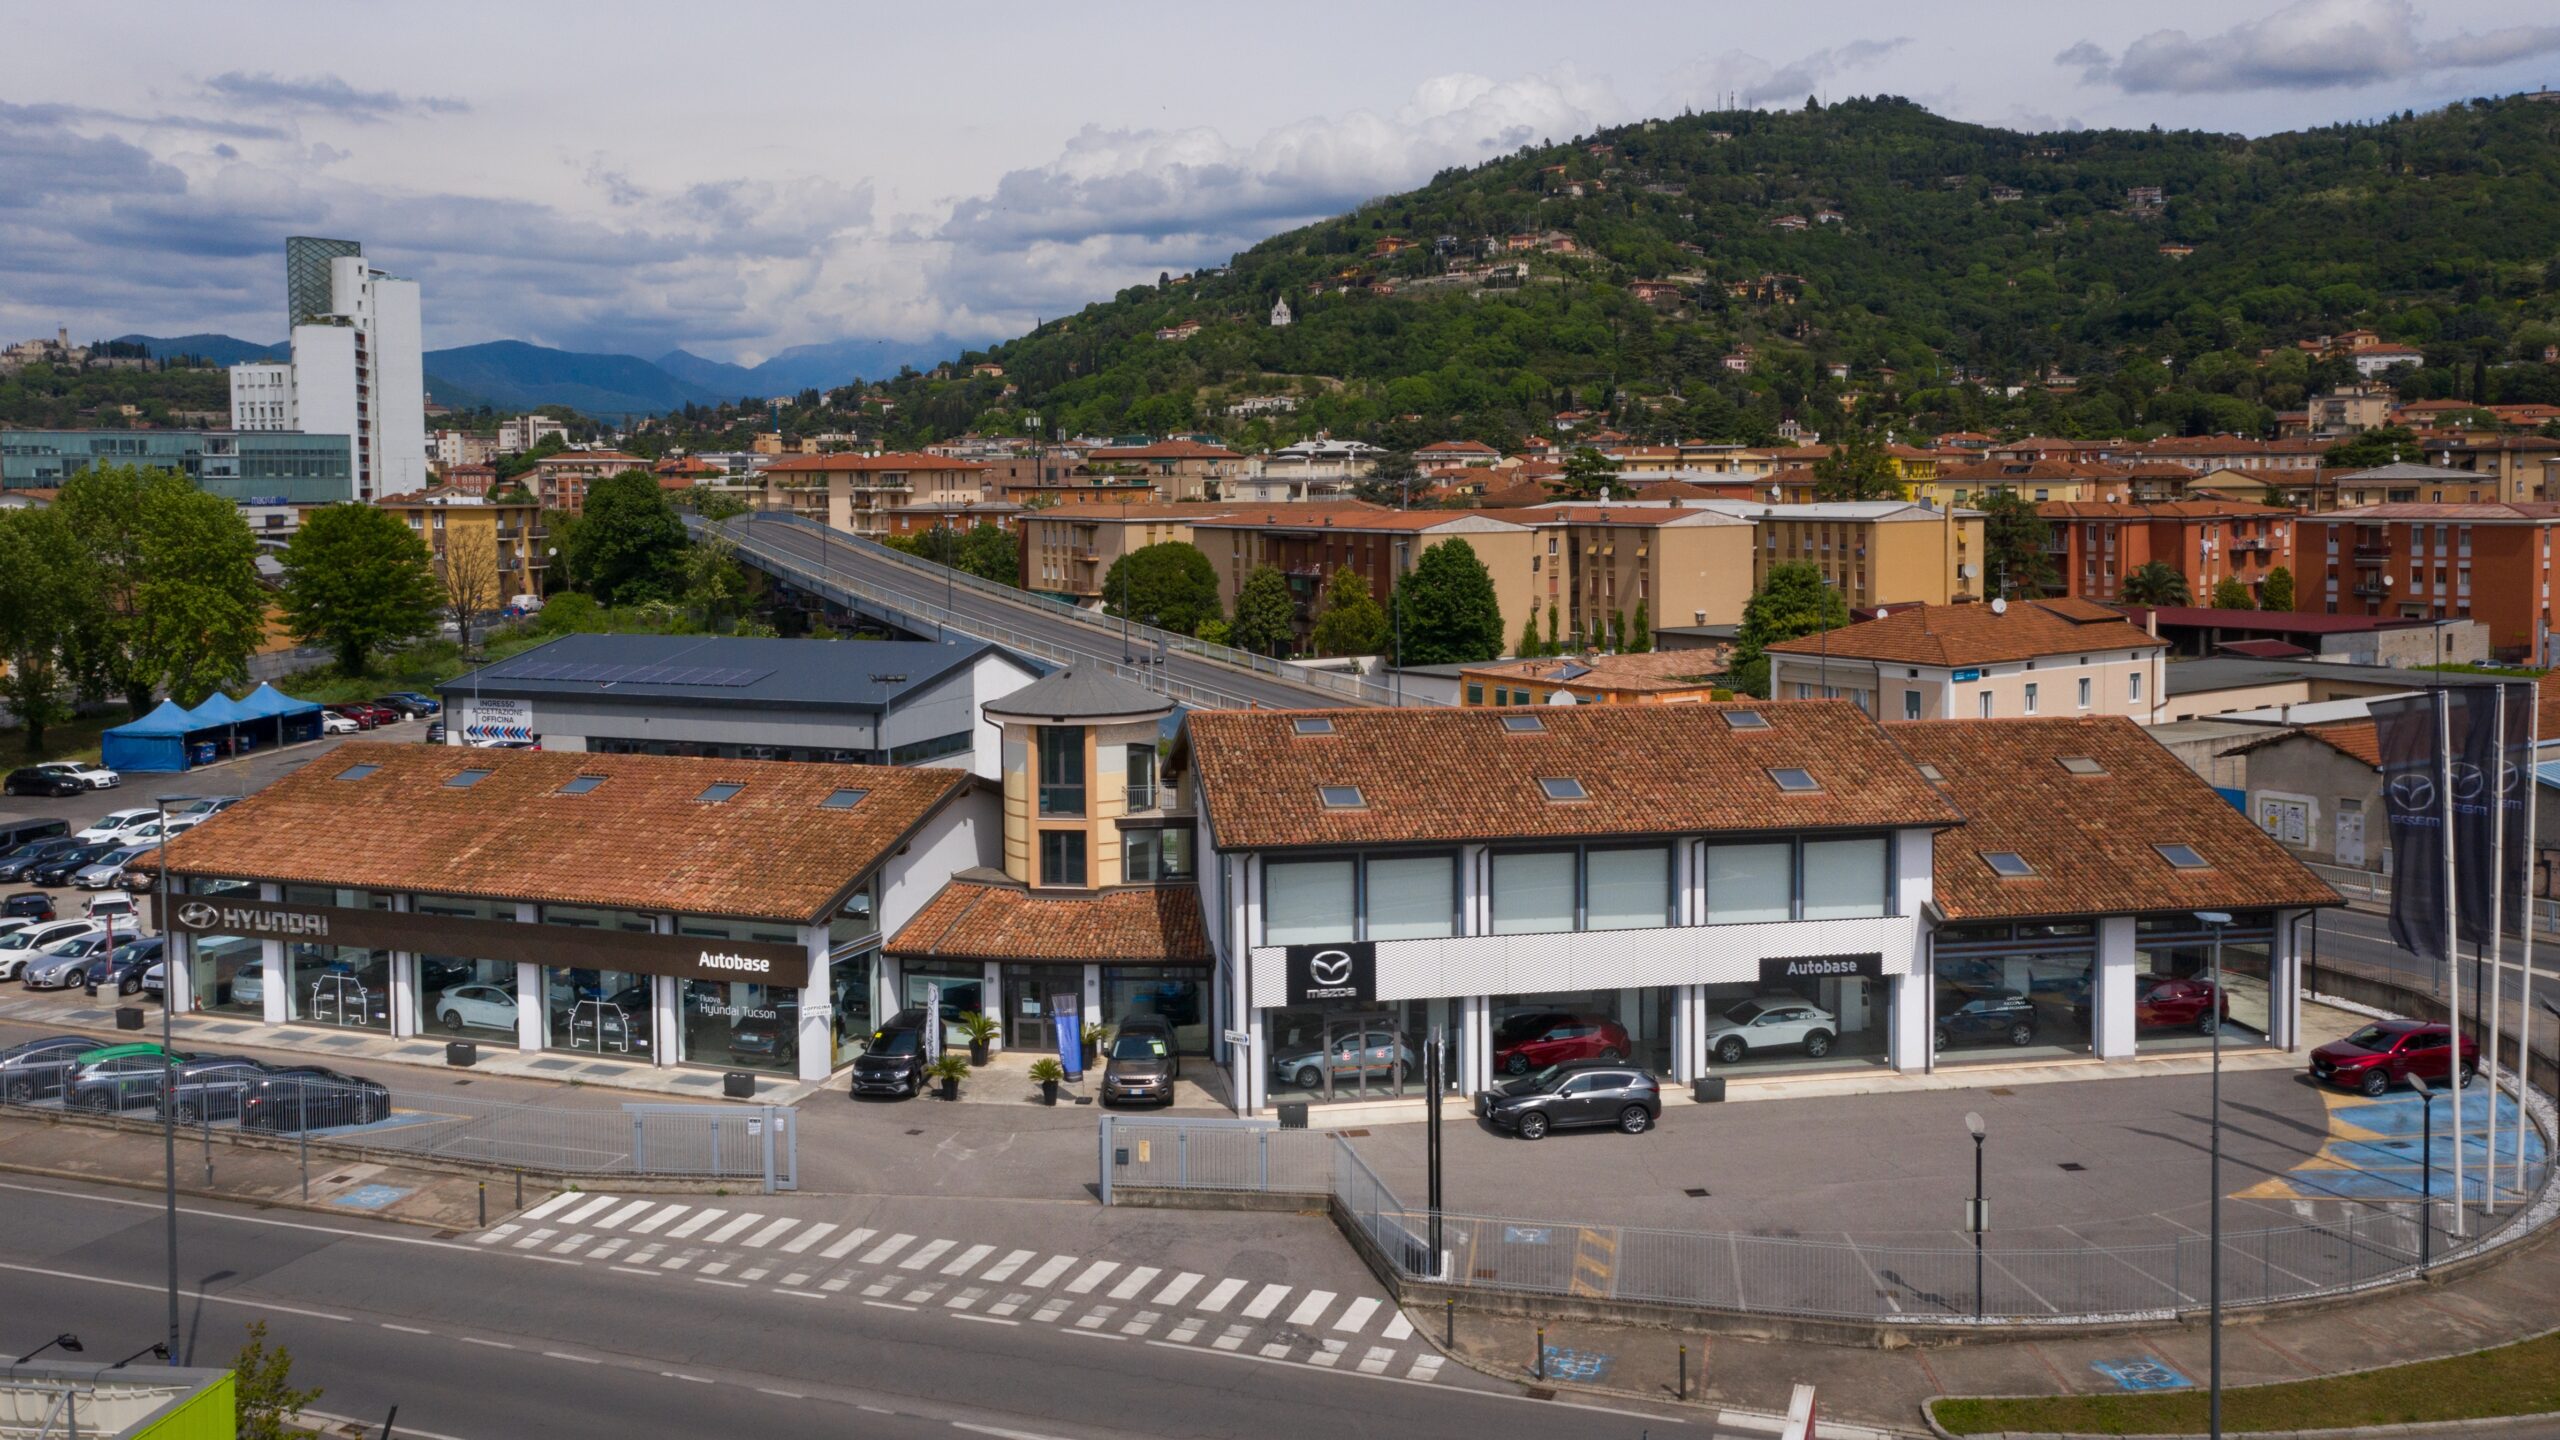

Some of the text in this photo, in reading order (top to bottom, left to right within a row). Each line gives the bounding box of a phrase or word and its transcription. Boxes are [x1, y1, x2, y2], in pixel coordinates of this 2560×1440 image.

[479, 699, 515, 707] INGRESSO
[472, 708, 524, 716] ACCETTAZIONE
[223, 908, 329, 936] HYUNDAI
[698, 951, 770, 972] Autobase
[1787, 960, 1858, 976] Autobase
[1306, 987, 1358, 999] mazda
[700, 1003, 776, 1020] Hyundai Tucson
